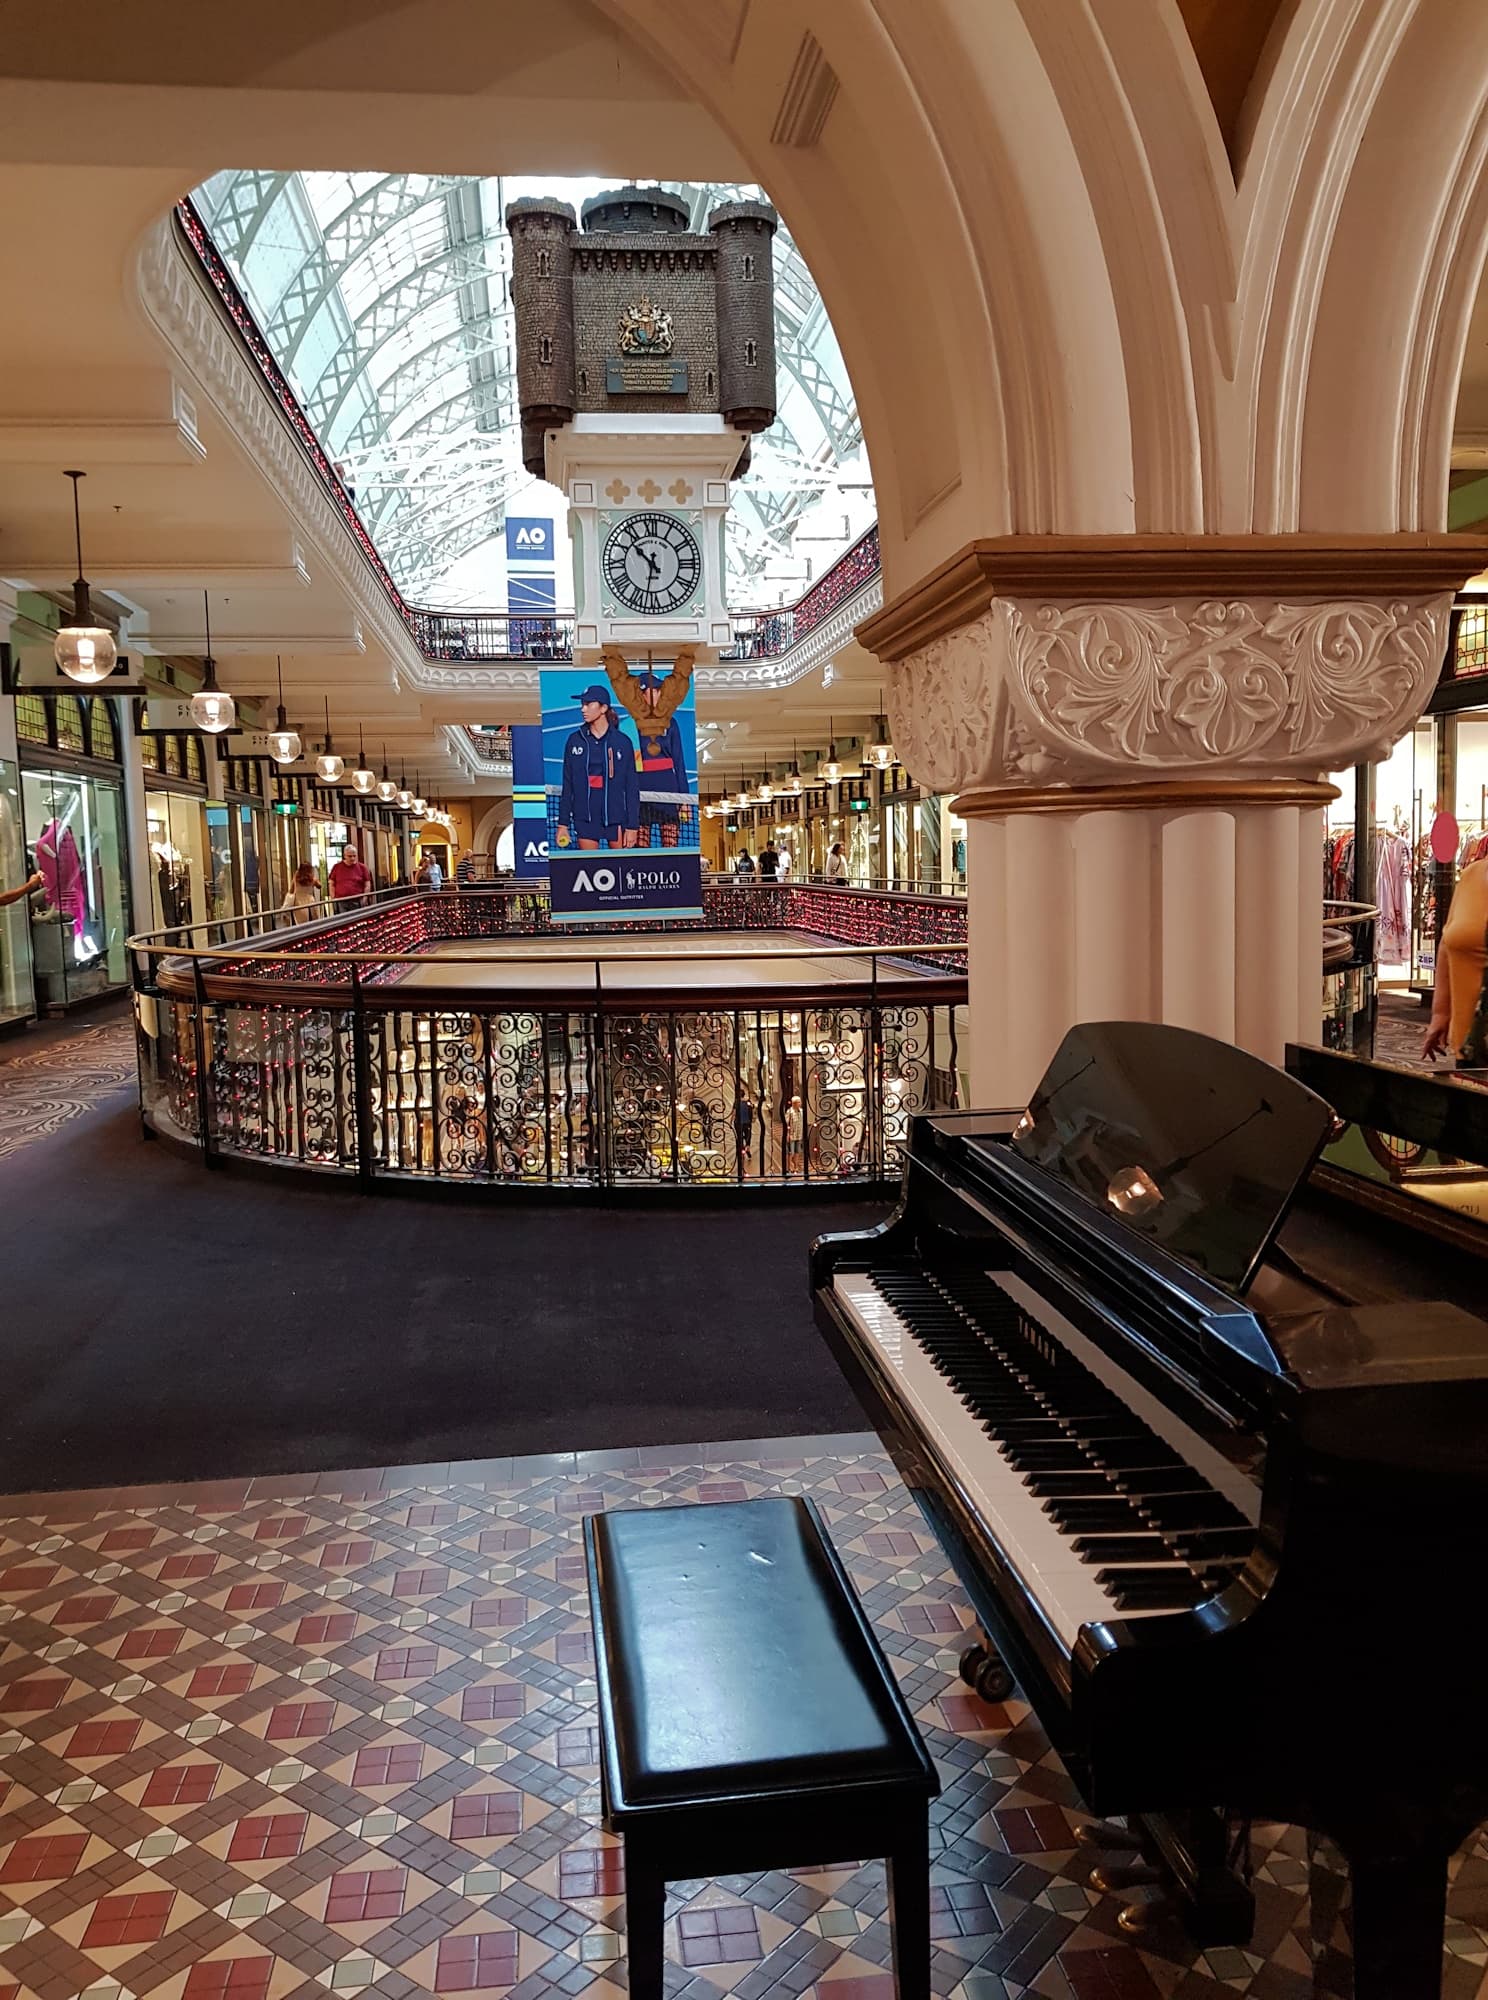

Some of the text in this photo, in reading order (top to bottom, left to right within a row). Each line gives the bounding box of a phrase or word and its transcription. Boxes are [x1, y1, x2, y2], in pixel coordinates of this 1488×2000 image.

[515, 527, 546, 544] AO
[572, 868, 680, 892] AO POLO
